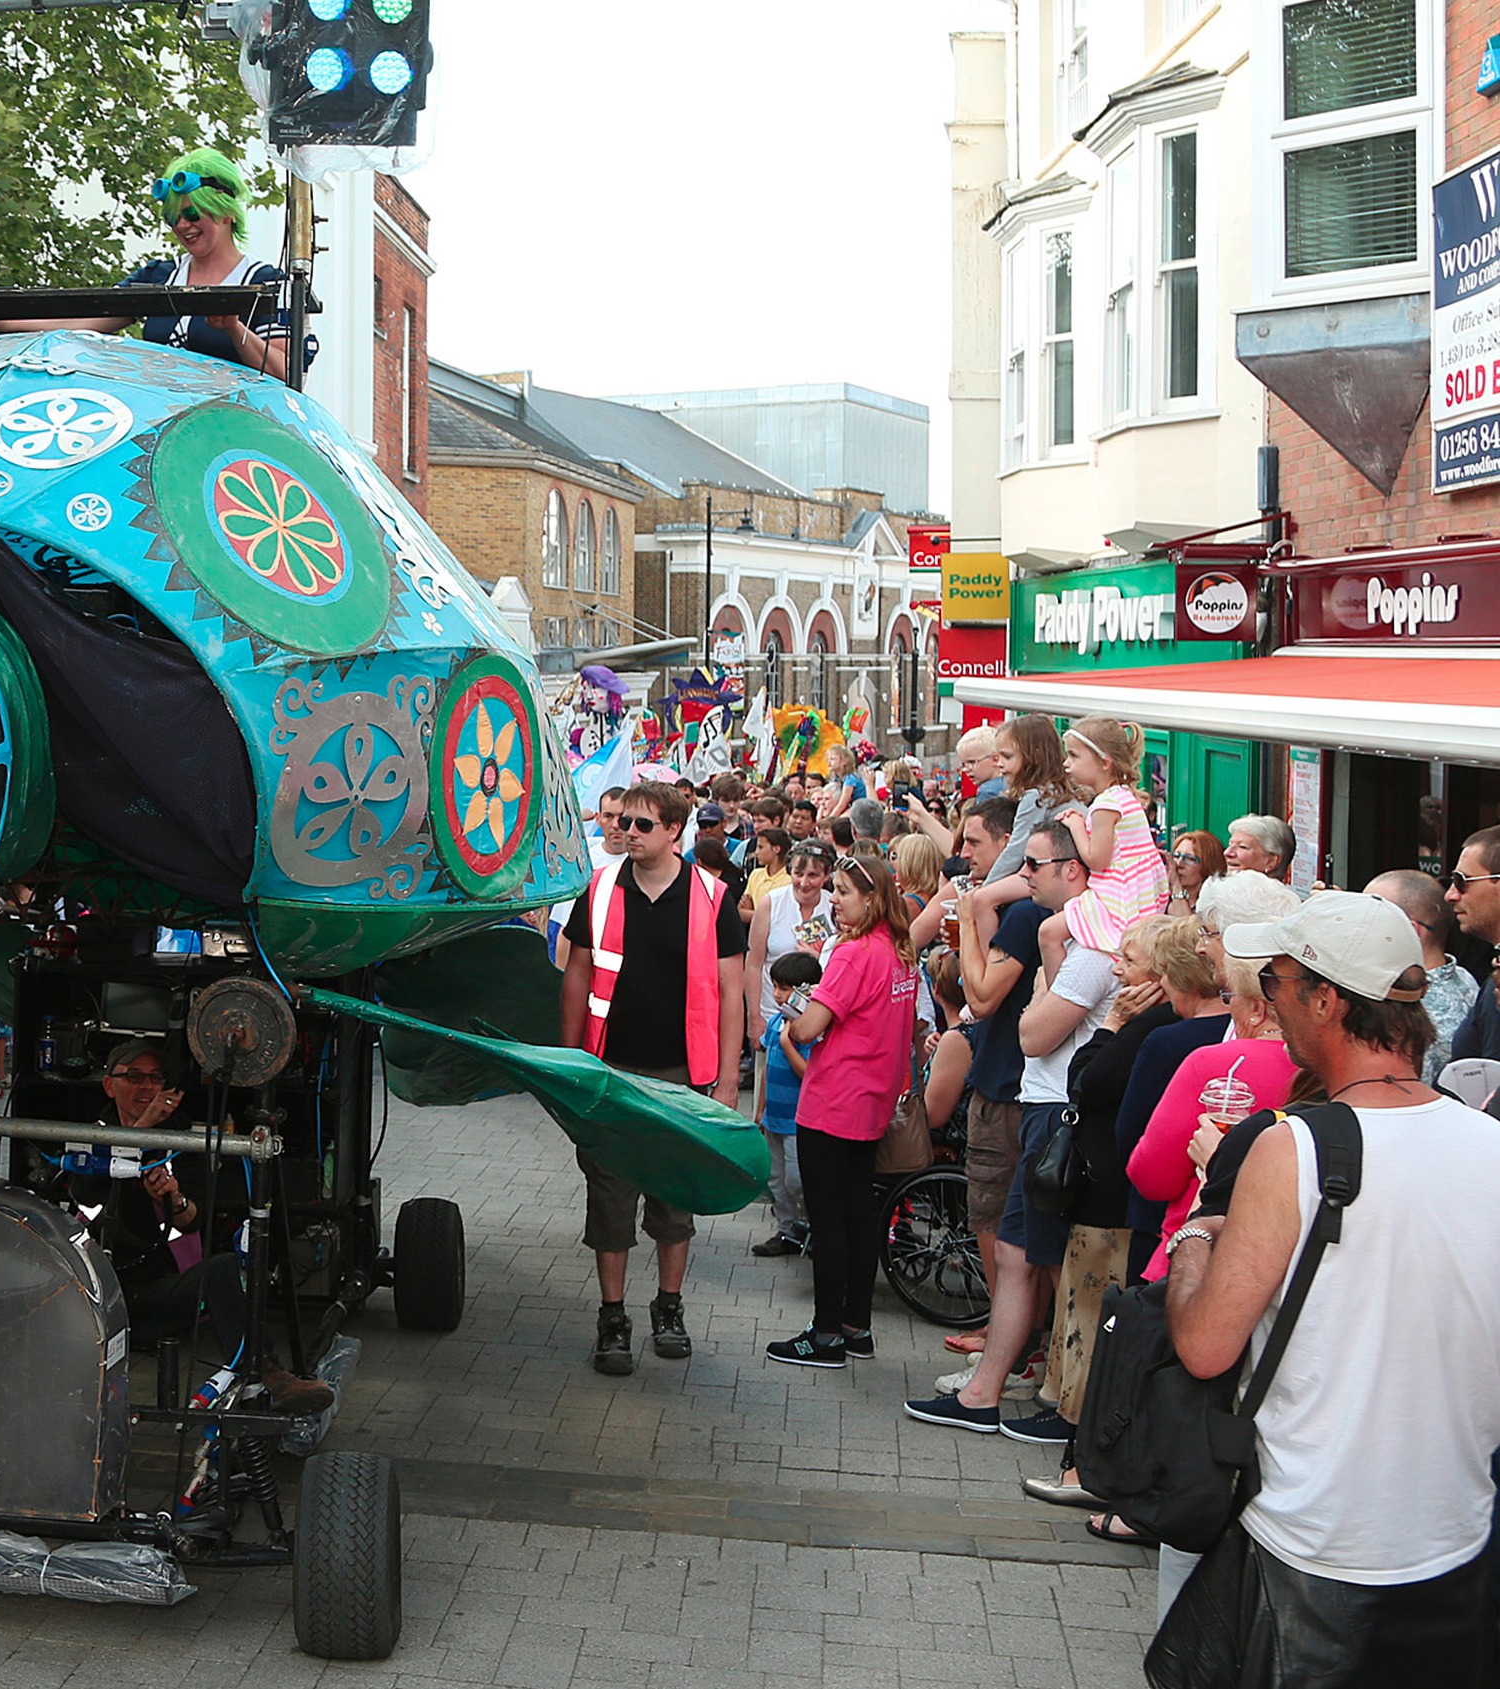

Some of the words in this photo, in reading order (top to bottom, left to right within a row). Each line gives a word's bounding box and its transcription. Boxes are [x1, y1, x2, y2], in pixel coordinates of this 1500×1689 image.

[1439, 225, 1500, 279] WOODF
[1456, 272, 1478, 295] AND
[1453, 310, 1484, 334] Office
[1466, 344, 1475, 359] to
[1445, 364, 1486, 408] SOLD
[1440, 427, 1478, 462] 01256
[949, 573, 1002, 587] Paddy
[949, 587, 1003, 599] Power
[1366, 572, 1459, 636] Poppins
[1195, 599, 1243, 613] Poppins
[1034, 589, 1093, 656] Paddy
[1093, 586, 1167, 643] Power
